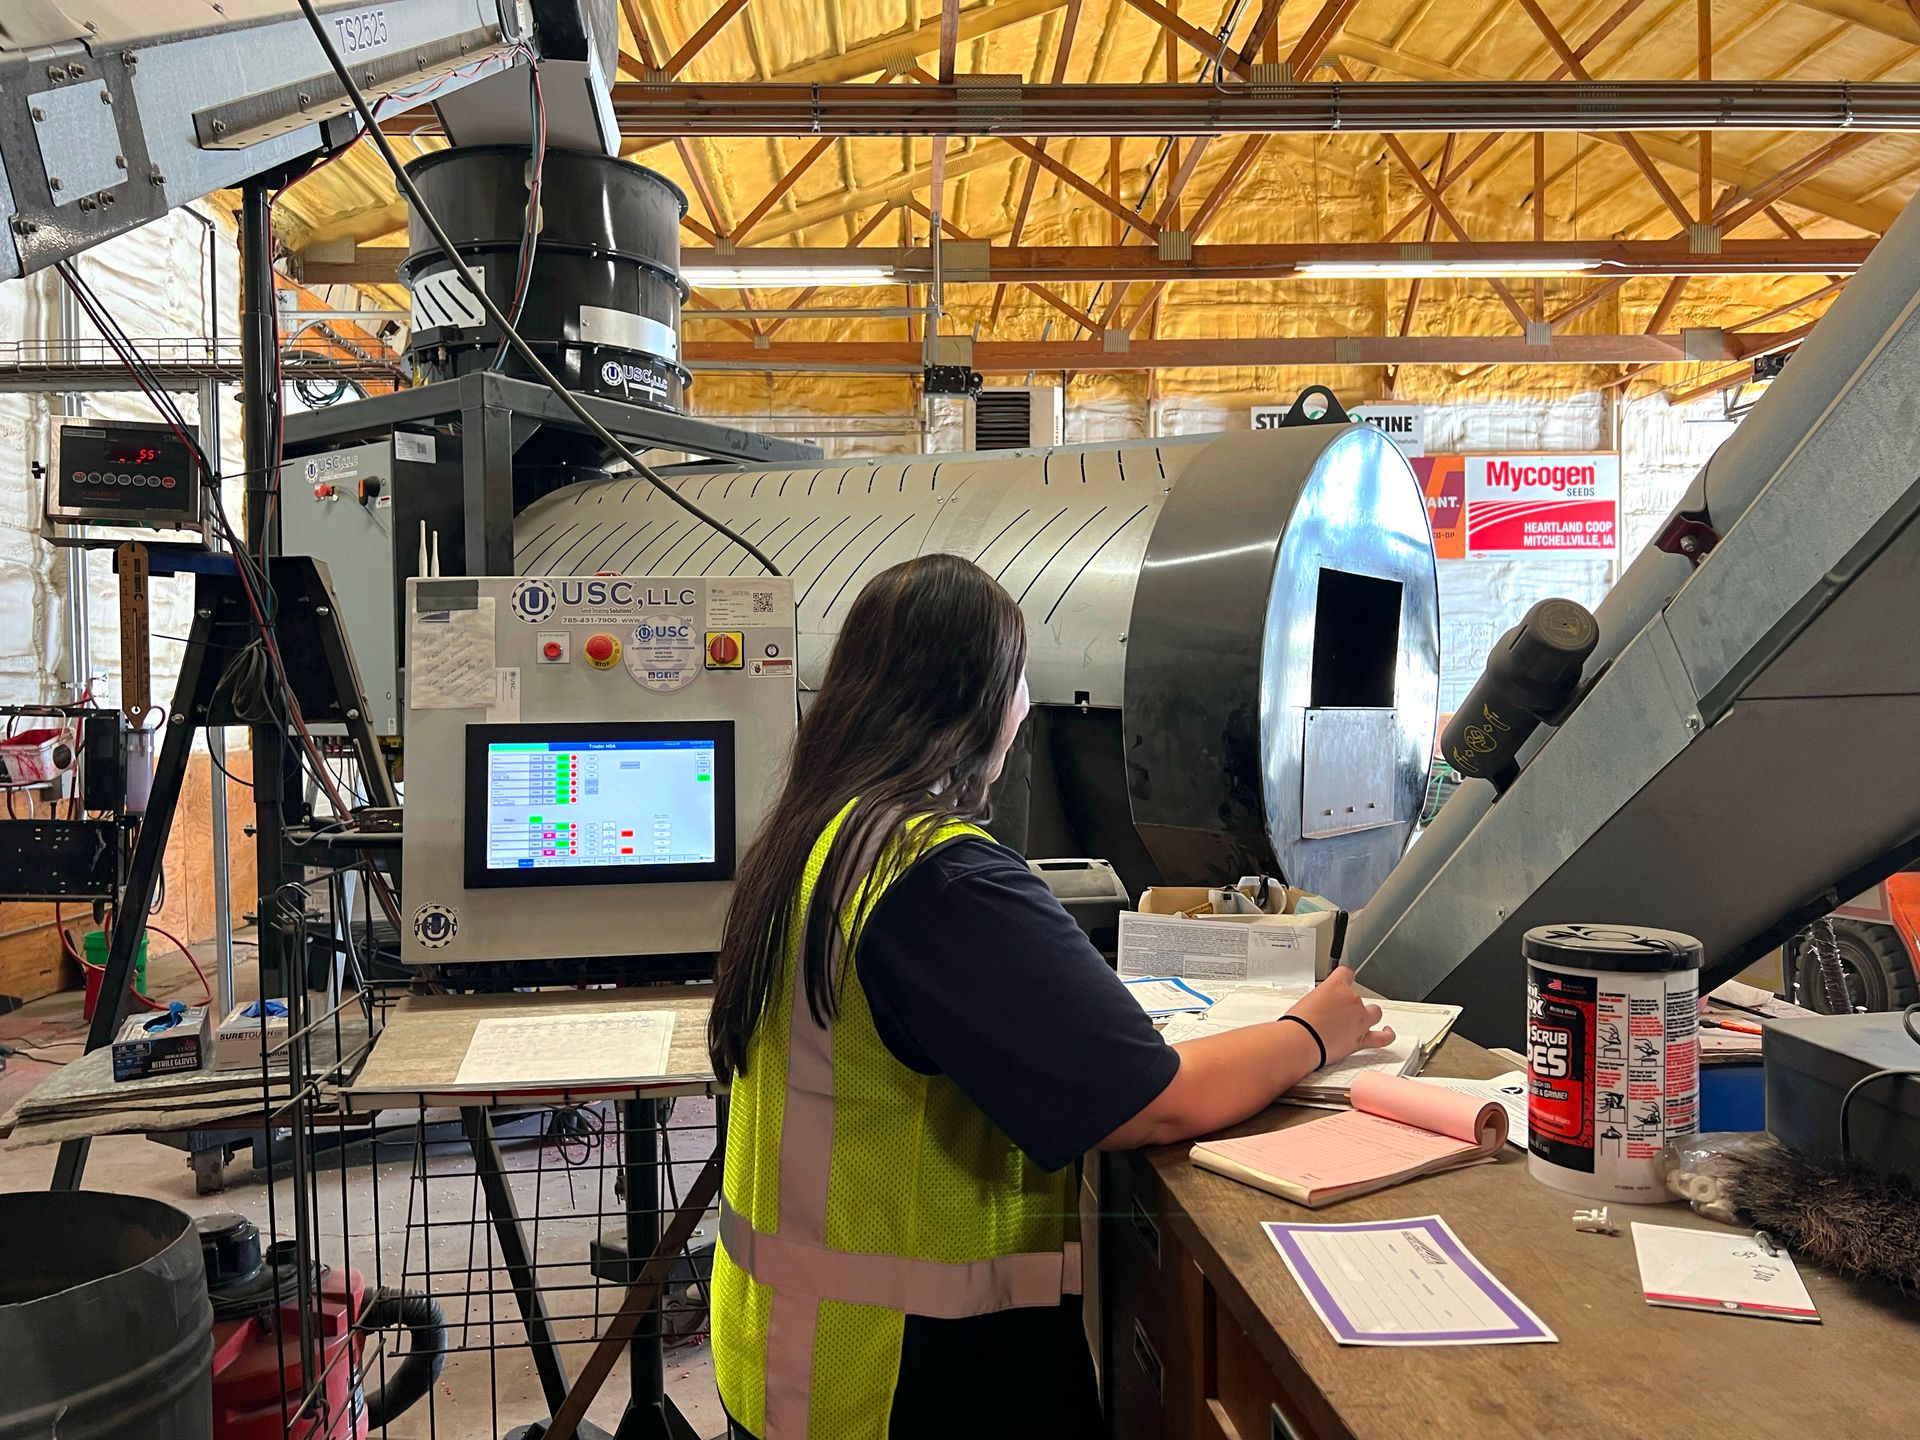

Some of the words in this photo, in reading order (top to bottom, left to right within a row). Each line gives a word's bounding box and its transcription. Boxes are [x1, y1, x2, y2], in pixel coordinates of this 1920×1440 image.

[335, 11, 388, 54] TS2525
[139, 449, 155, 460] 55
[1486, 461, 1595, 491] Mycogen
[1566, 487, 1595, 497] SEEDS
[1524, 521, 1583, 533] HEARTLAND
[1585, 521, 1613, 533] COOP
[1524, 534, 1601, 547] MITCHELLVILLE,
[1602, 534, 1614, 546] IA
[647, 589, 695, 605] LLC
[592, 607, 609, 615] Treating
[655, 625, 689, 637] USC
[220, 1030, 274, 1041] SURETOUH
[1530, 1025, 1568, 1047] SCRUB
[151, 1059, 174, 1069] NITRILE
[174, 1056, 197, 1066] GLOVES
